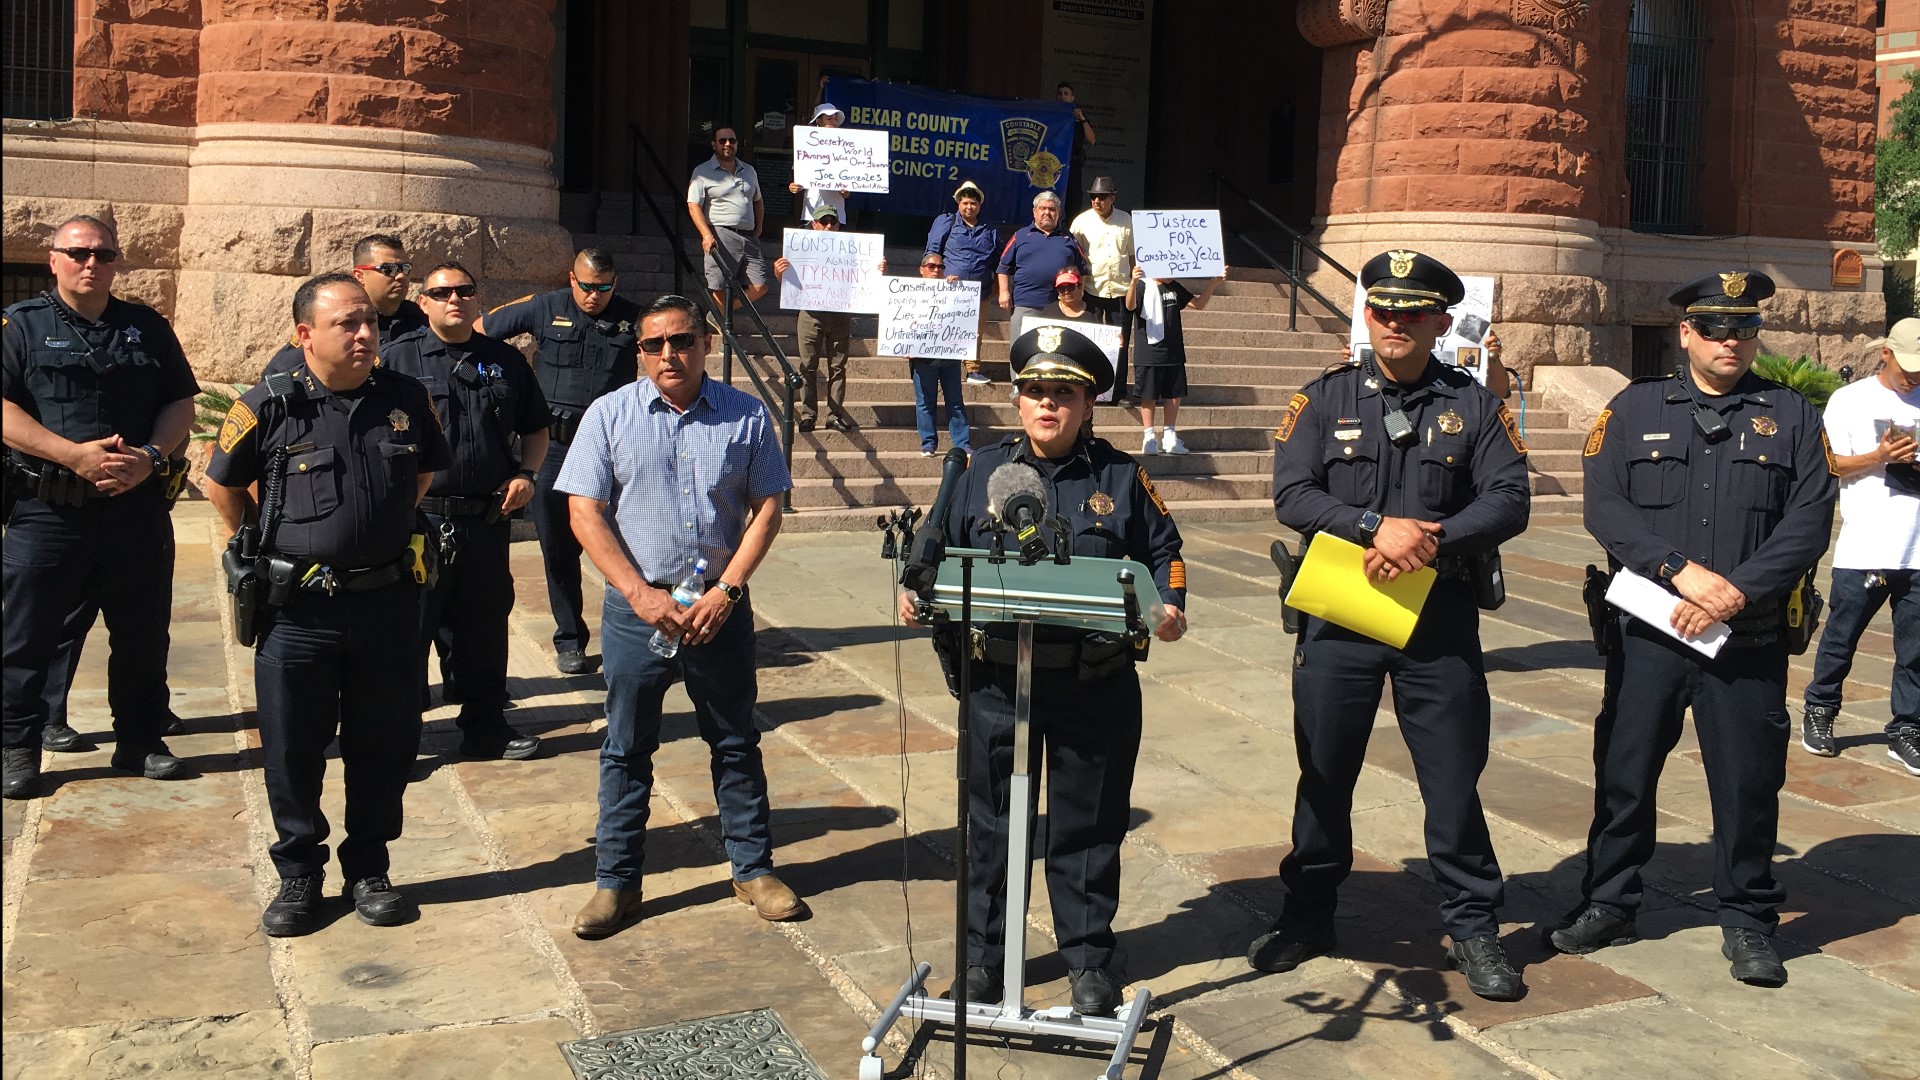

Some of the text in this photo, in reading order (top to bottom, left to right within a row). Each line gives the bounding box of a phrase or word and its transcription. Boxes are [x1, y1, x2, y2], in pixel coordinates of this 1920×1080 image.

[850, 106, 970, 135] BEXAR COUNTY
[1005, 121, 1042, 132] CONSTABLE
[843, 147, 873, 157] World
[889, 134, 930, 155] BLES
[934, 139, 990, 161] OFFICE
[814, 168, 835, 181] Joe
[889, 158, 946, 179] CINCT
[948, 166, 959, 181] 2
[809, 181, 832, 189] Need
[1146, 211, 1208, 229] Justice
[790, 231, 876, 257] CONSTABLE
[1169, 230, 1198, 248] FOR
[825, 256, 869, 268] AGAINST
[1135, 245, 1221, 263] Constable Vela
[799, 264, 871, 284] TYRANNY
[1167, 261, 1202, 276] PCT 2
[825, 286, 848, 299] AND
[888, 278, 936, 298] Consenting
[936, 281, 980, 296] Undermining
[892, 305, 914, 321] Lies
[928, 305, 977, 323] Propaganda
[909, 320, 944, 330] Creates
[918, 342, 968, 356] Communities
